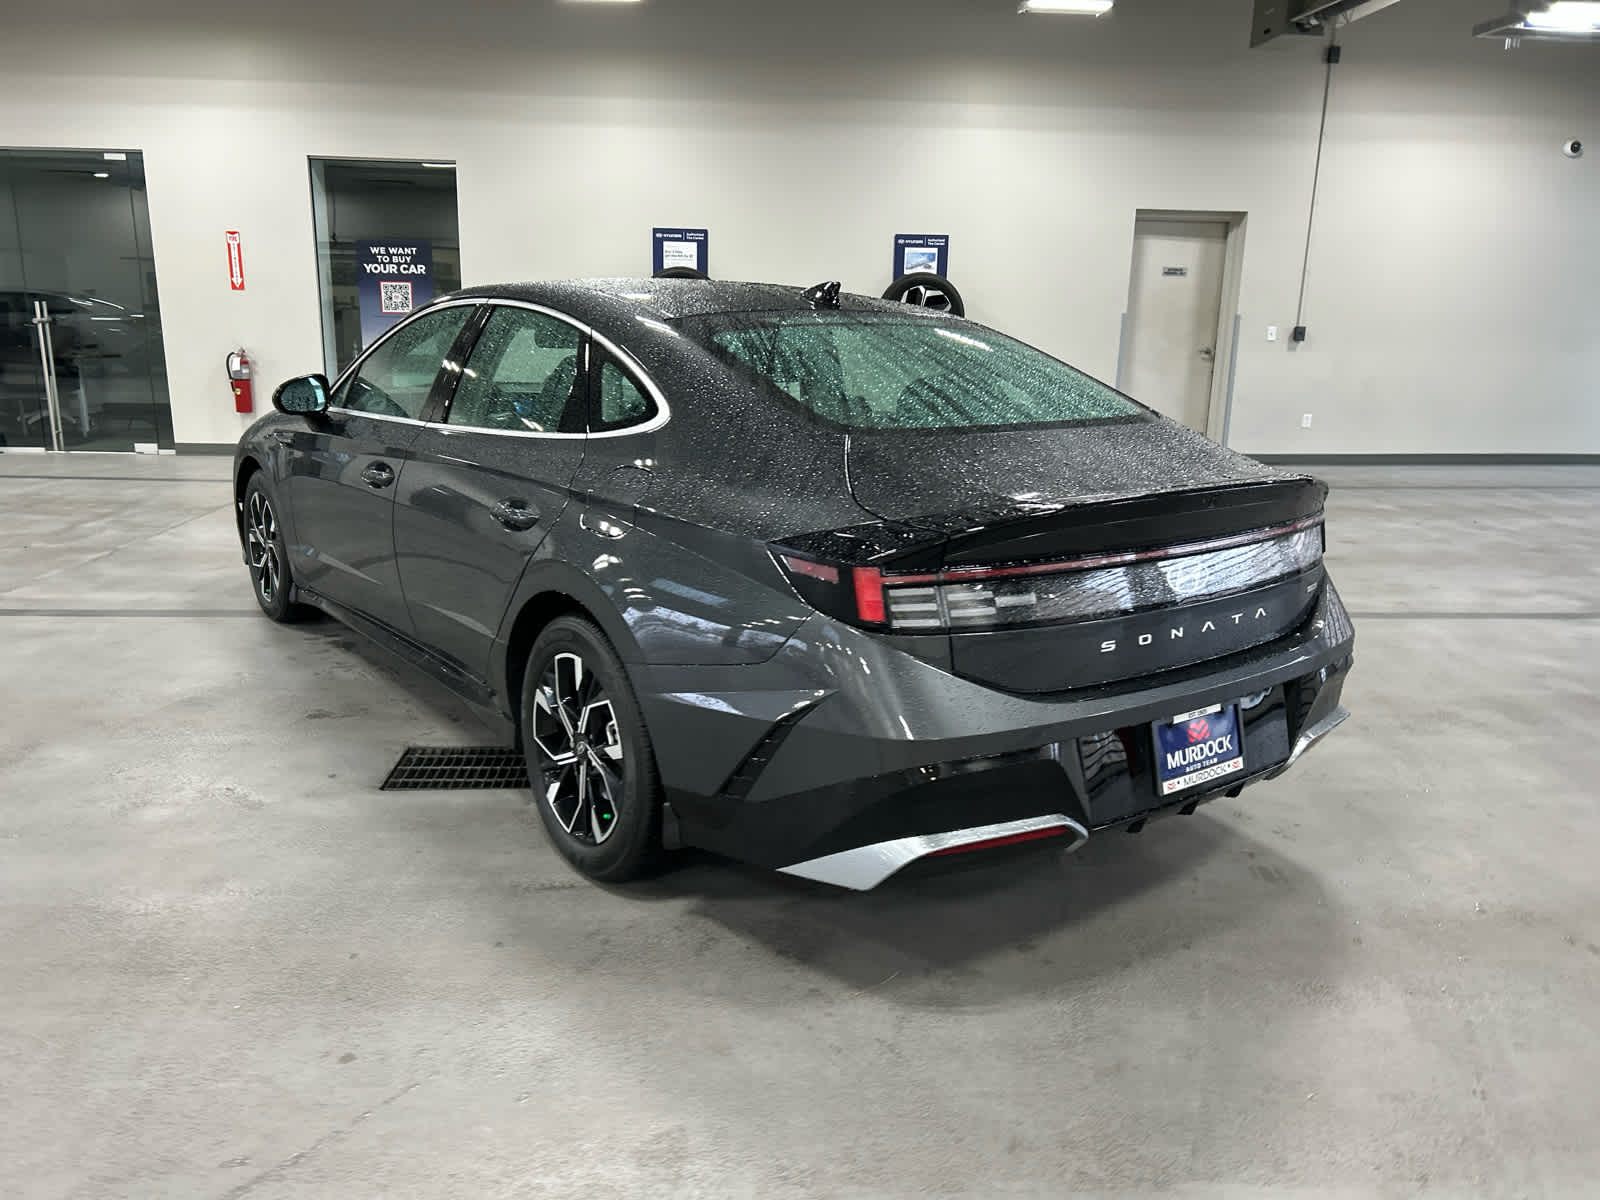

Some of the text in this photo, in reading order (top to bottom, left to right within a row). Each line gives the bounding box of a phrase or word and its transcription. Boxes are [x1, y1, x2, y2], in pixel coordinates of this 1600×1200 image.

[369, 246, 417, 255] WE WANT
[376, 255, 412, 263] TO BUY
[363, 263, 426, 274] YOUR CAR
[1100, 607, 1267, 653] SONATA
[1166, 734, 1233, 770] MURDOCK
[1185, 762, 1202, 773] AUTO
[1183, 766, 1227, 787] MURDOCK
